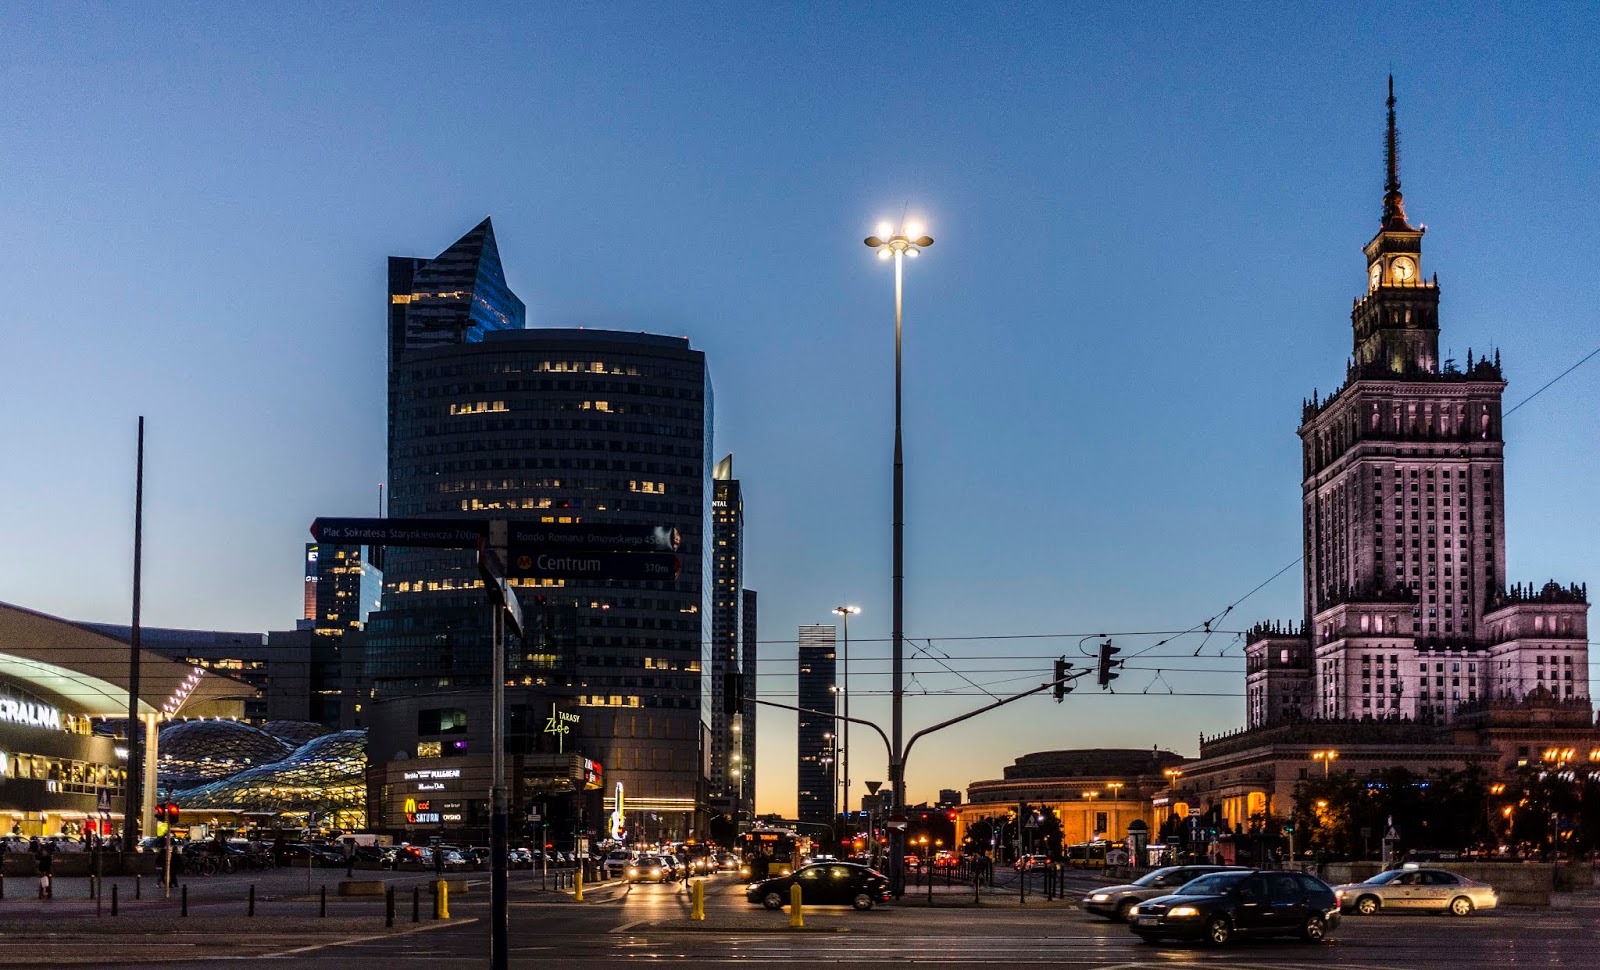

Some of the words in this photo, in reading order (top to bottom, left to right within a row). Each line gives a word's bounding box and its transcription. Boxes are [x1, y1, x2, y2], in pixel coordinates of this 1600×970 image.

[322, 526, 341, 537] Plac
[343, 527, 387, 539] Sokratesa
[389, 528, 453, 541] Starynkiewicza
[516, 531, 545, 542] Rondo
[548, 532, 584, 543] Romana
[587, 533, 643, 546] Dmowskiego
[536, 554, 602, 572] Centrum
[644, 563, 669, 573] 370m
[558, 711, 581, 723] TARASY
[416, 813, 439, 823] SATURN
